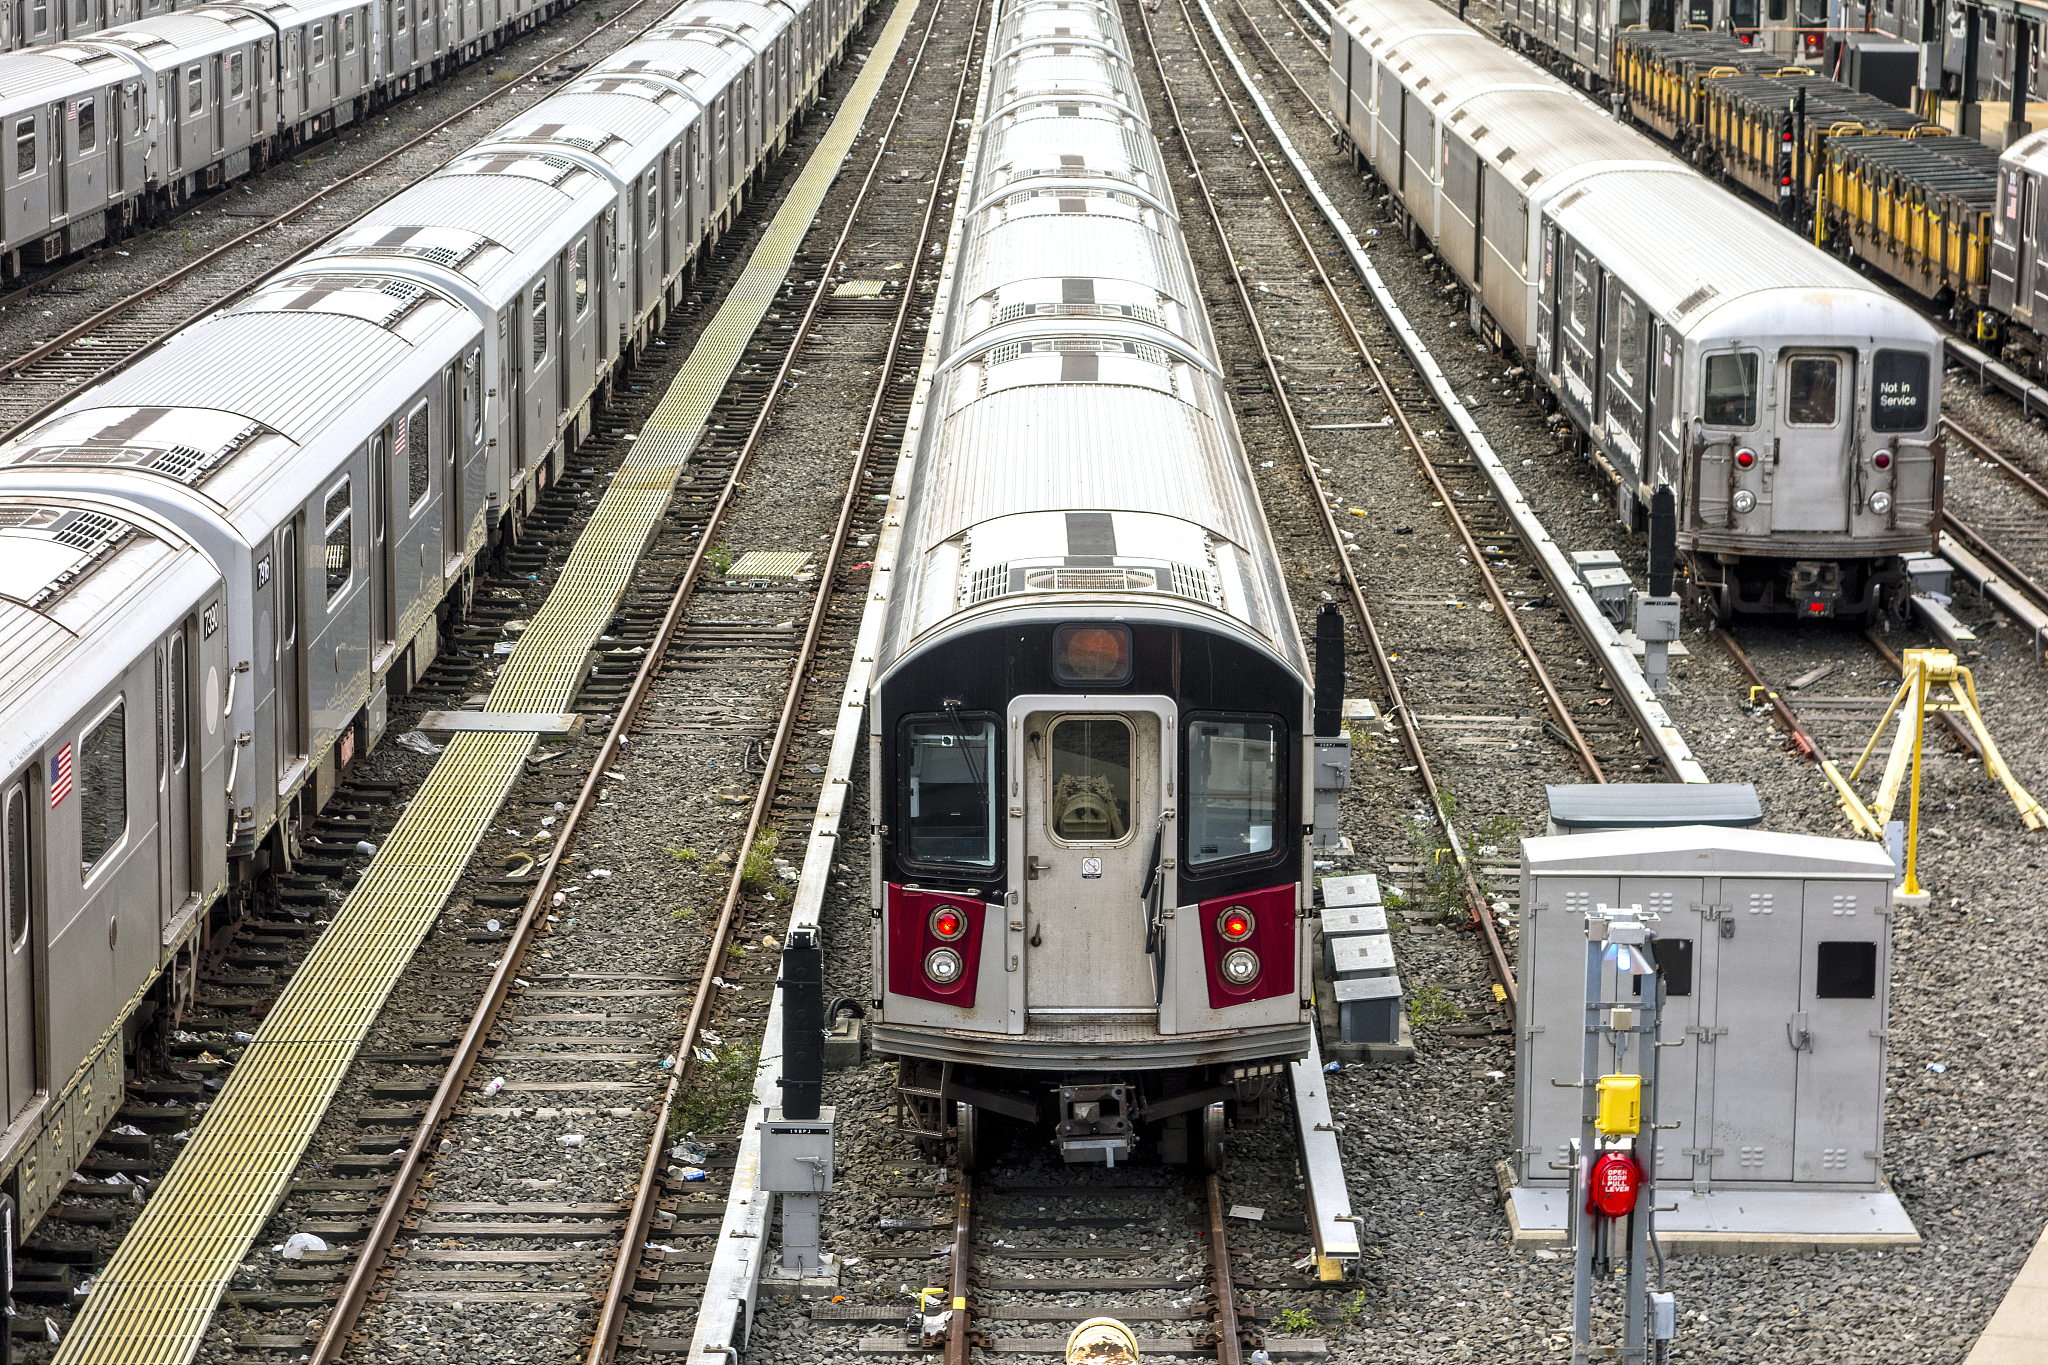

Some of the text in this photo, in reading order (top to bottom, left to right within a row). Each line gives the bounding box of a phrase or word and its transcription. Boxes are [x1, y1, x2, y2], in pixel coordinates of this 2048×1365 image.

[1880, 381, 1910, 393] Not in
[1880, 395, 1917, 406] Service
